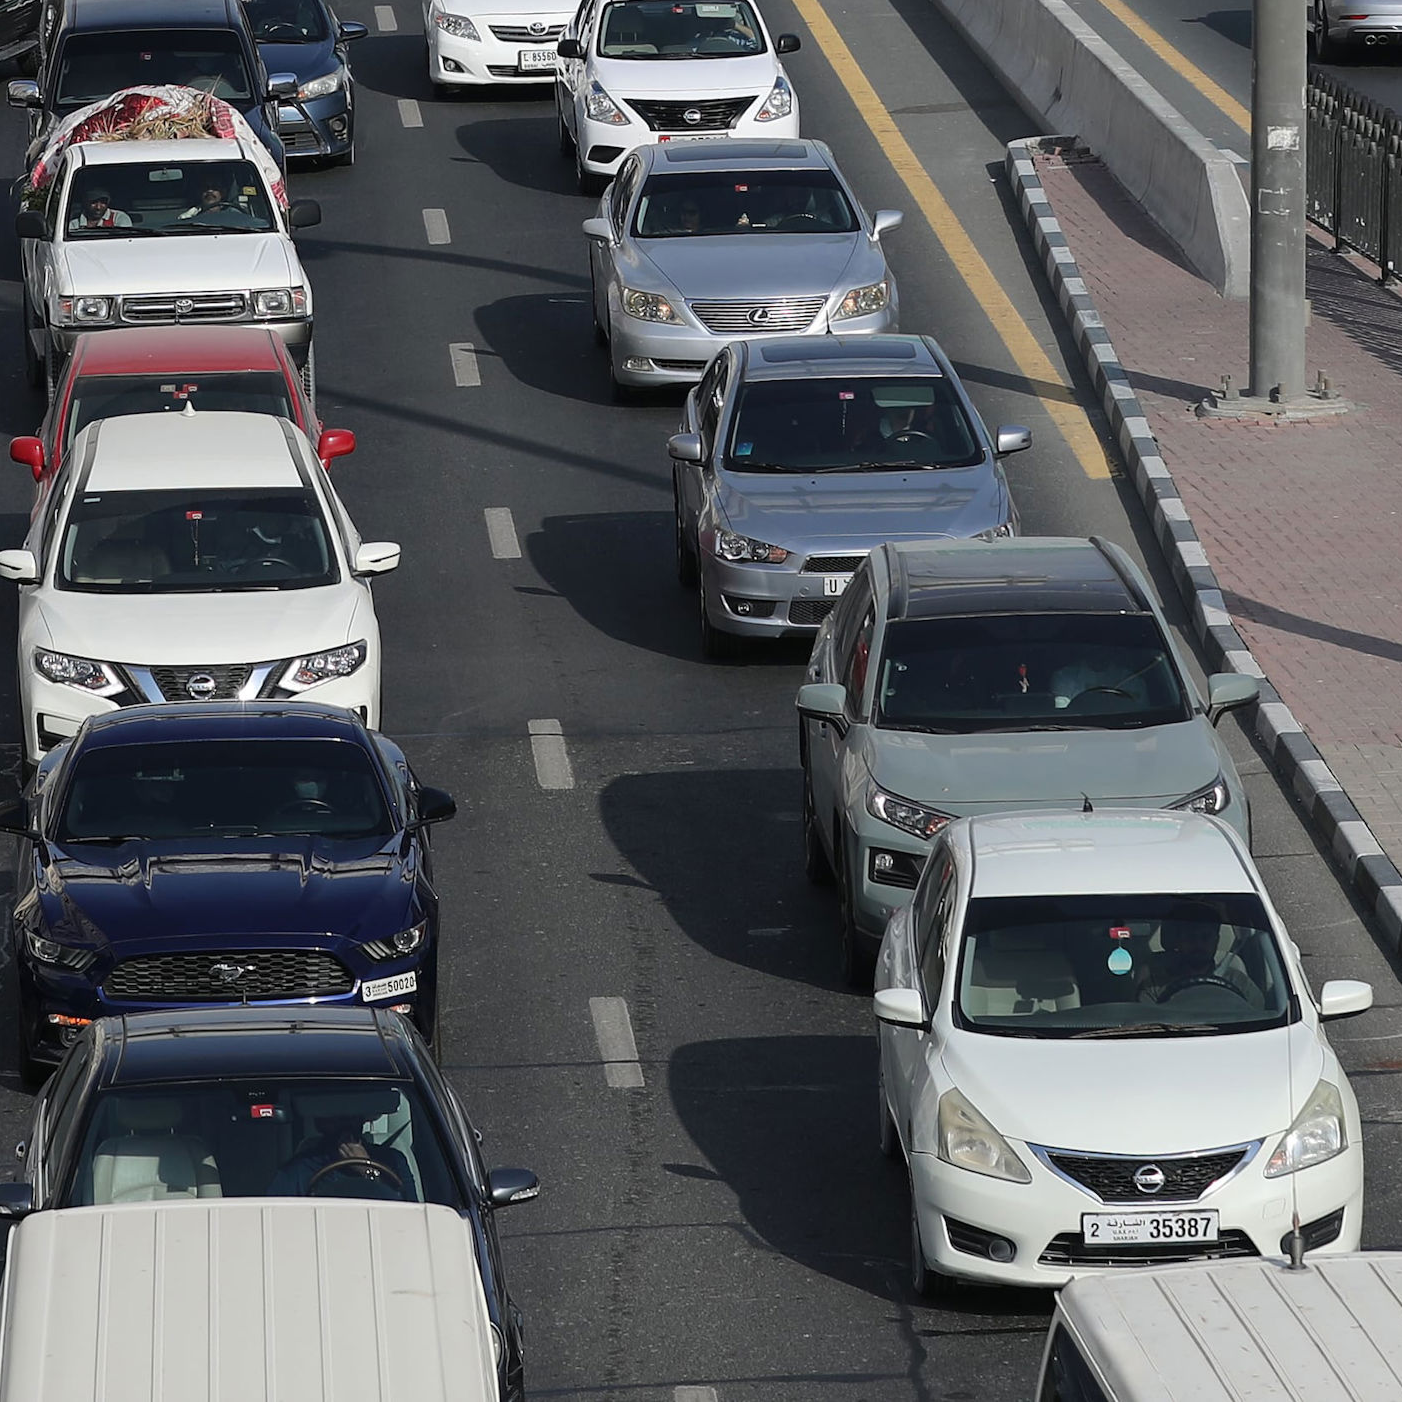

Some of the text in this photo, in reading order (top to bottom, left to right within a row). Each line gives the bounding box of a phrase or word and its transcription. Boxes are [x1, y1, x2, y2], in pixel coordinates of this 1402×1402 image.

[532, 51, 557, 63] 85560
[829, 578, 838, 595] U
[365, 975, 415, 998] 3 50020
[1090, 1217, 1212, 1240] 2 35387
